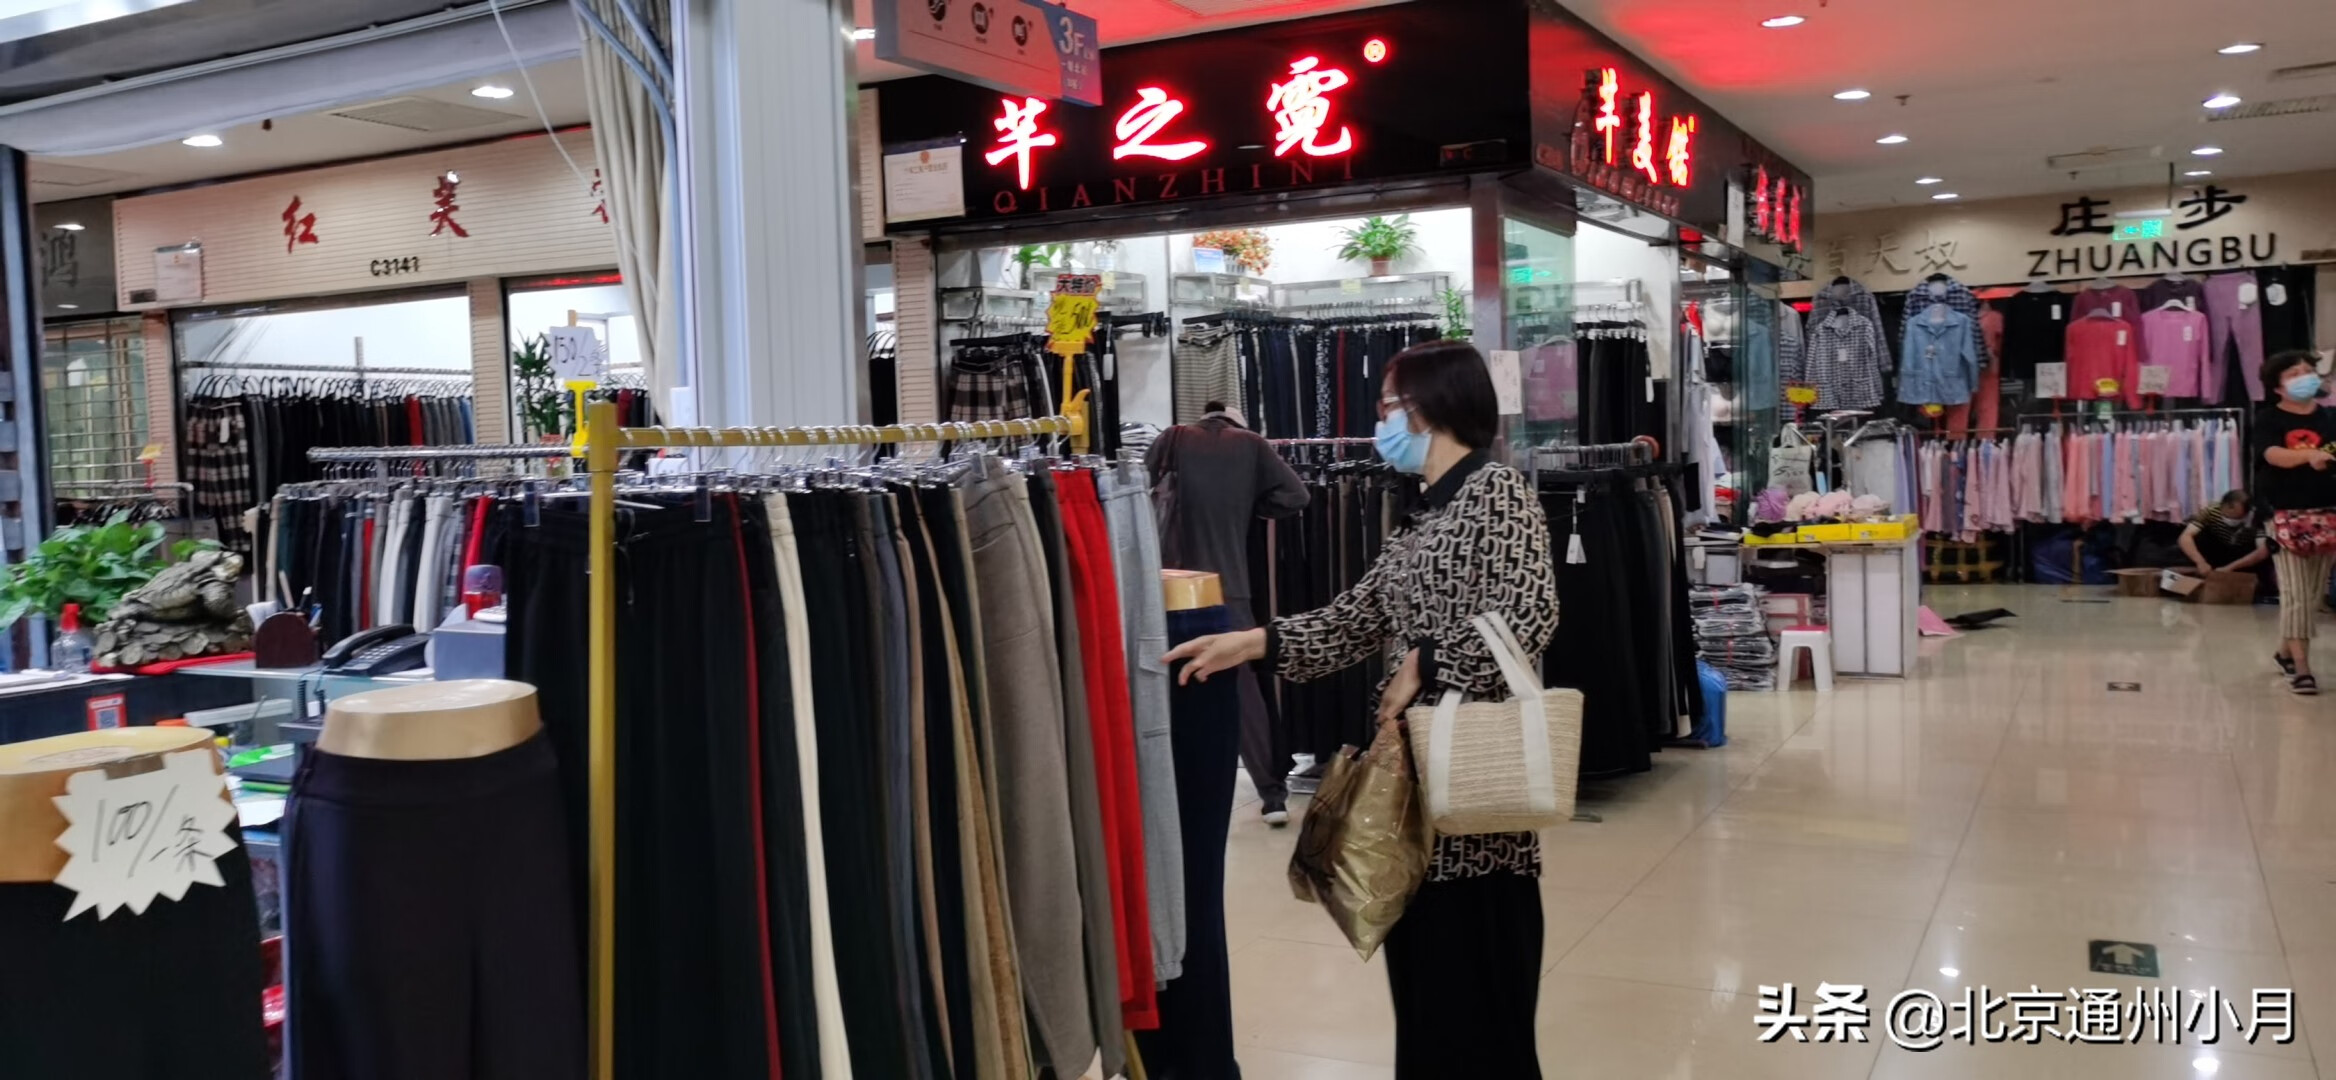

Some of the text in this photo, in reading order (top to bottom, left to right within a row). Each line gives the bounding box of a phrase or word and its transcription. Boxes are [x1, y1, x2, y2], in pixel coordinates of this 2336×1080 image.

[994, 157, 1353, 213] QIANZHINI
[2051, 185, 2247, 236] 庄步
[370, 256, 420, 277] C3141
[2027, 233, 2277, 277] ZHUANGBU
